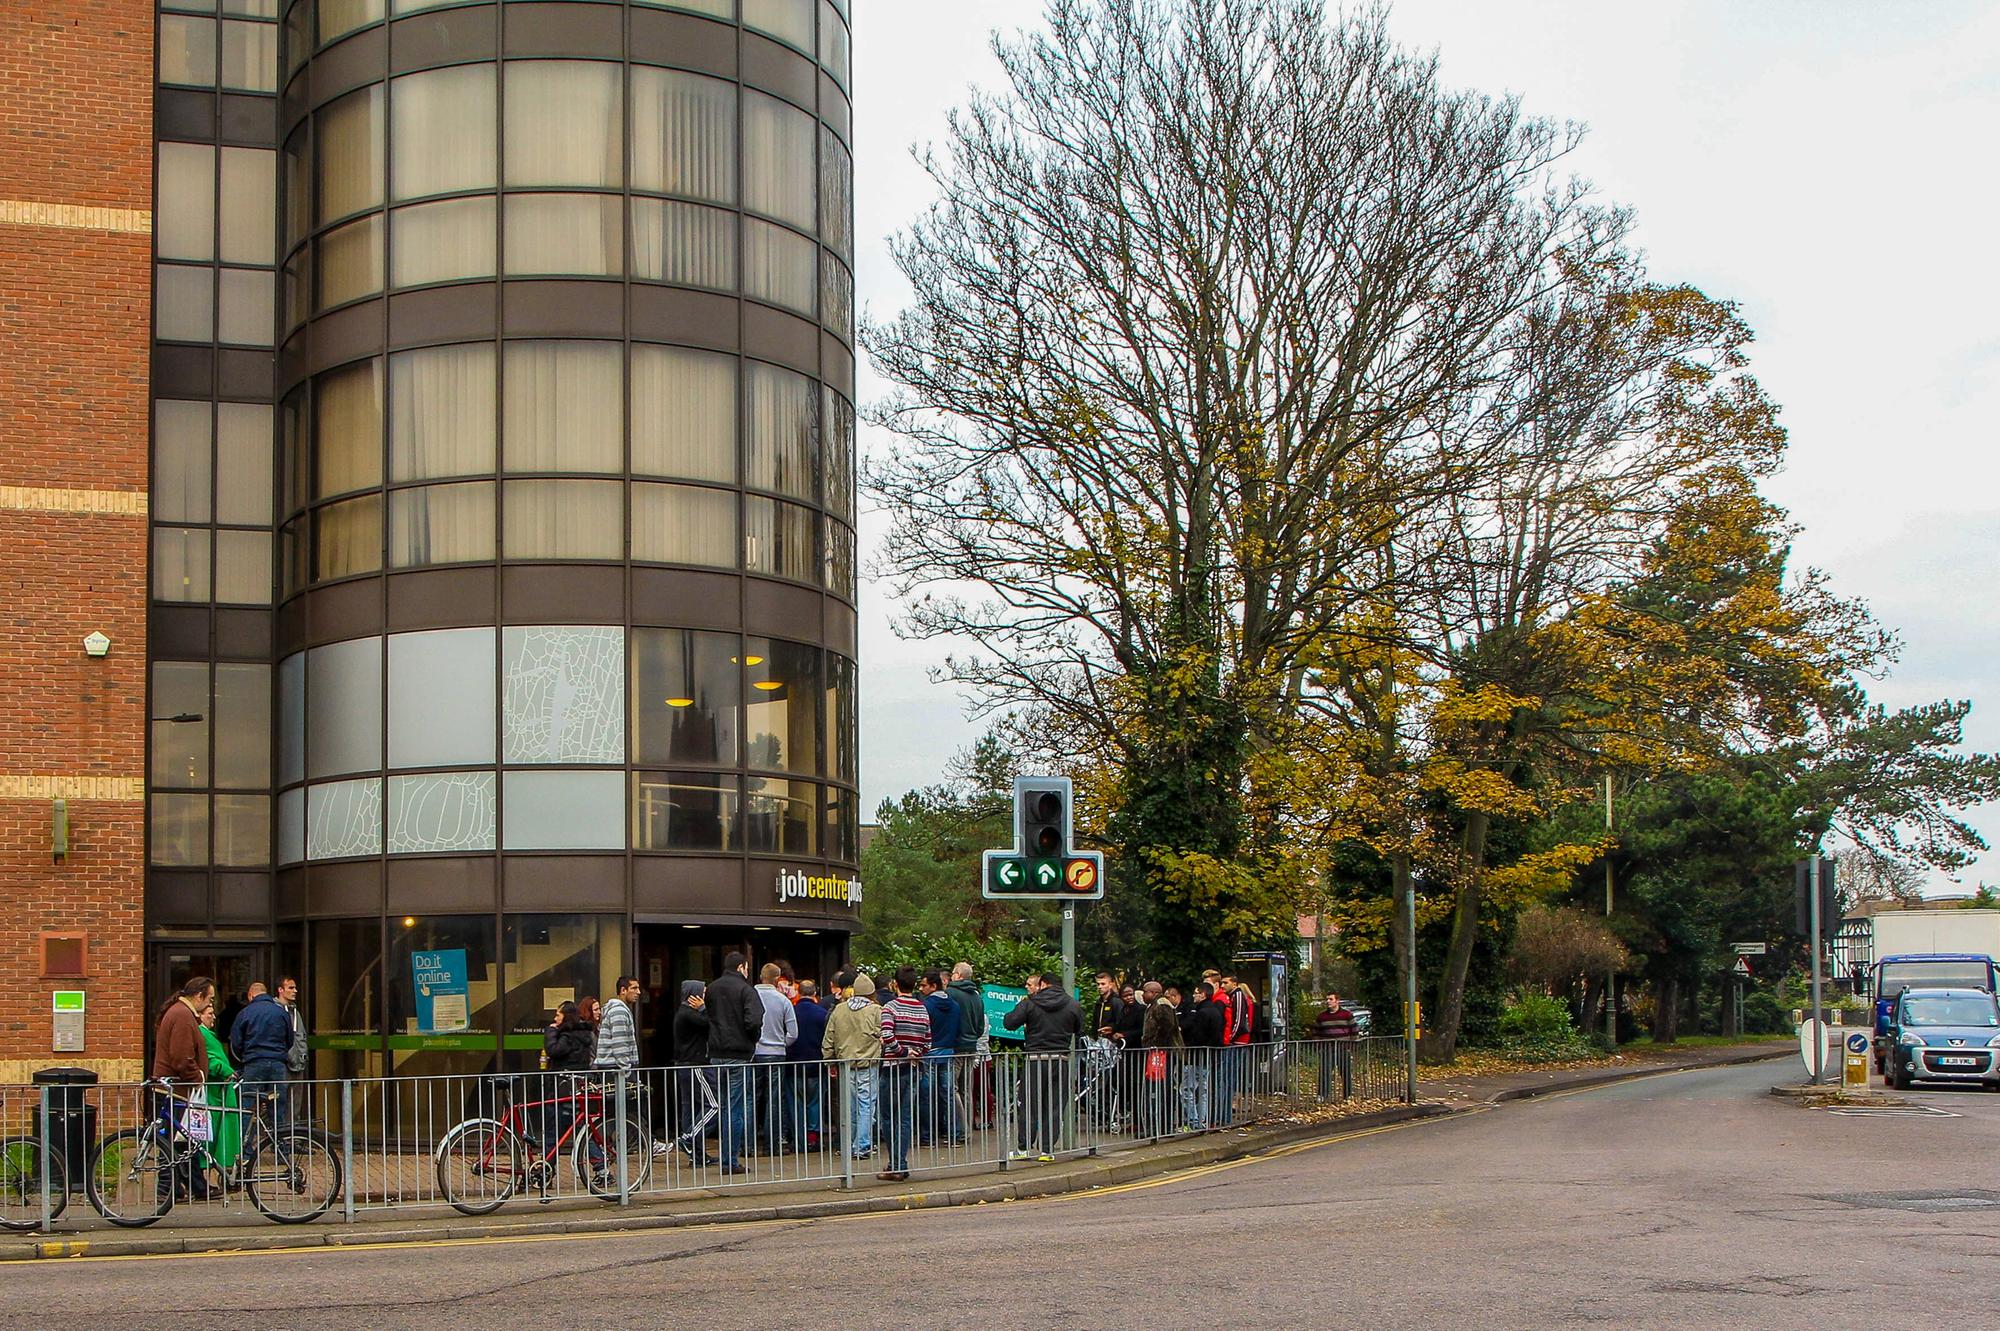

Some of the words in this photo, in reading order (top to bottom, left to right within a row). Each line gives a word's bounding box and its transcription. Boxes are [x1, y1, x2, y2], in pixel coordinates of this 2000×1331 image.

[779, 867, 862, 907] jobcentreplus
[415, 955, 431, 968] Do
[433, 954, 441, 967] it
[417, 970, 451, 983] online
